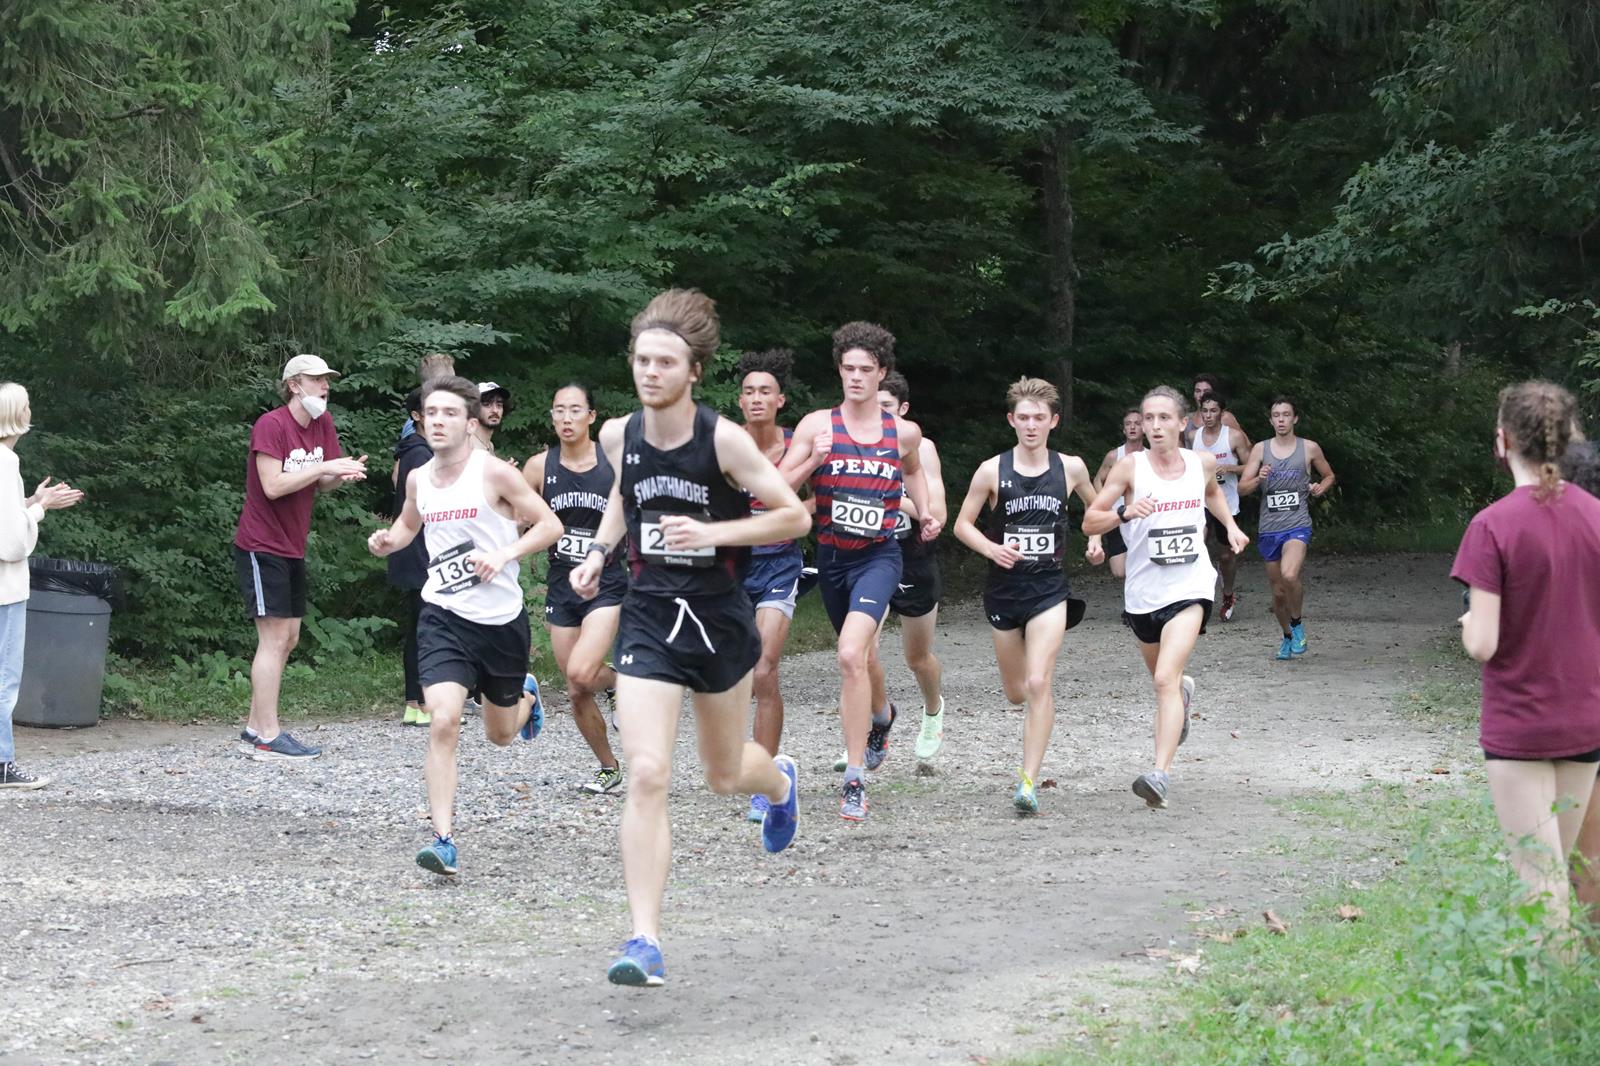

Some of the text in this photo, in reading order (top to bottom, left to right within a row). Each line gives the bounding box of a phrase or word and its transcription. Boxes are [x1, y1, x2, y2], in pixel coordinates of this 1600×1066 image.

[830, 458, 897, 480] PENN
[634, 475, 709, 505] SWARTHMORE
[1005, 494, 1061, 516] SWARTHMORE
[1270, 495, 1297, 507] 122
[423, 508, 478, 524] AVERFORD
[834, 505, 879, 527] 200
[561, 537, 585, 555] 21
[1155, 536, 1194, 556] 142
[435, 554, 476, 586] 136
[664, 556, 693, 567] Timing
